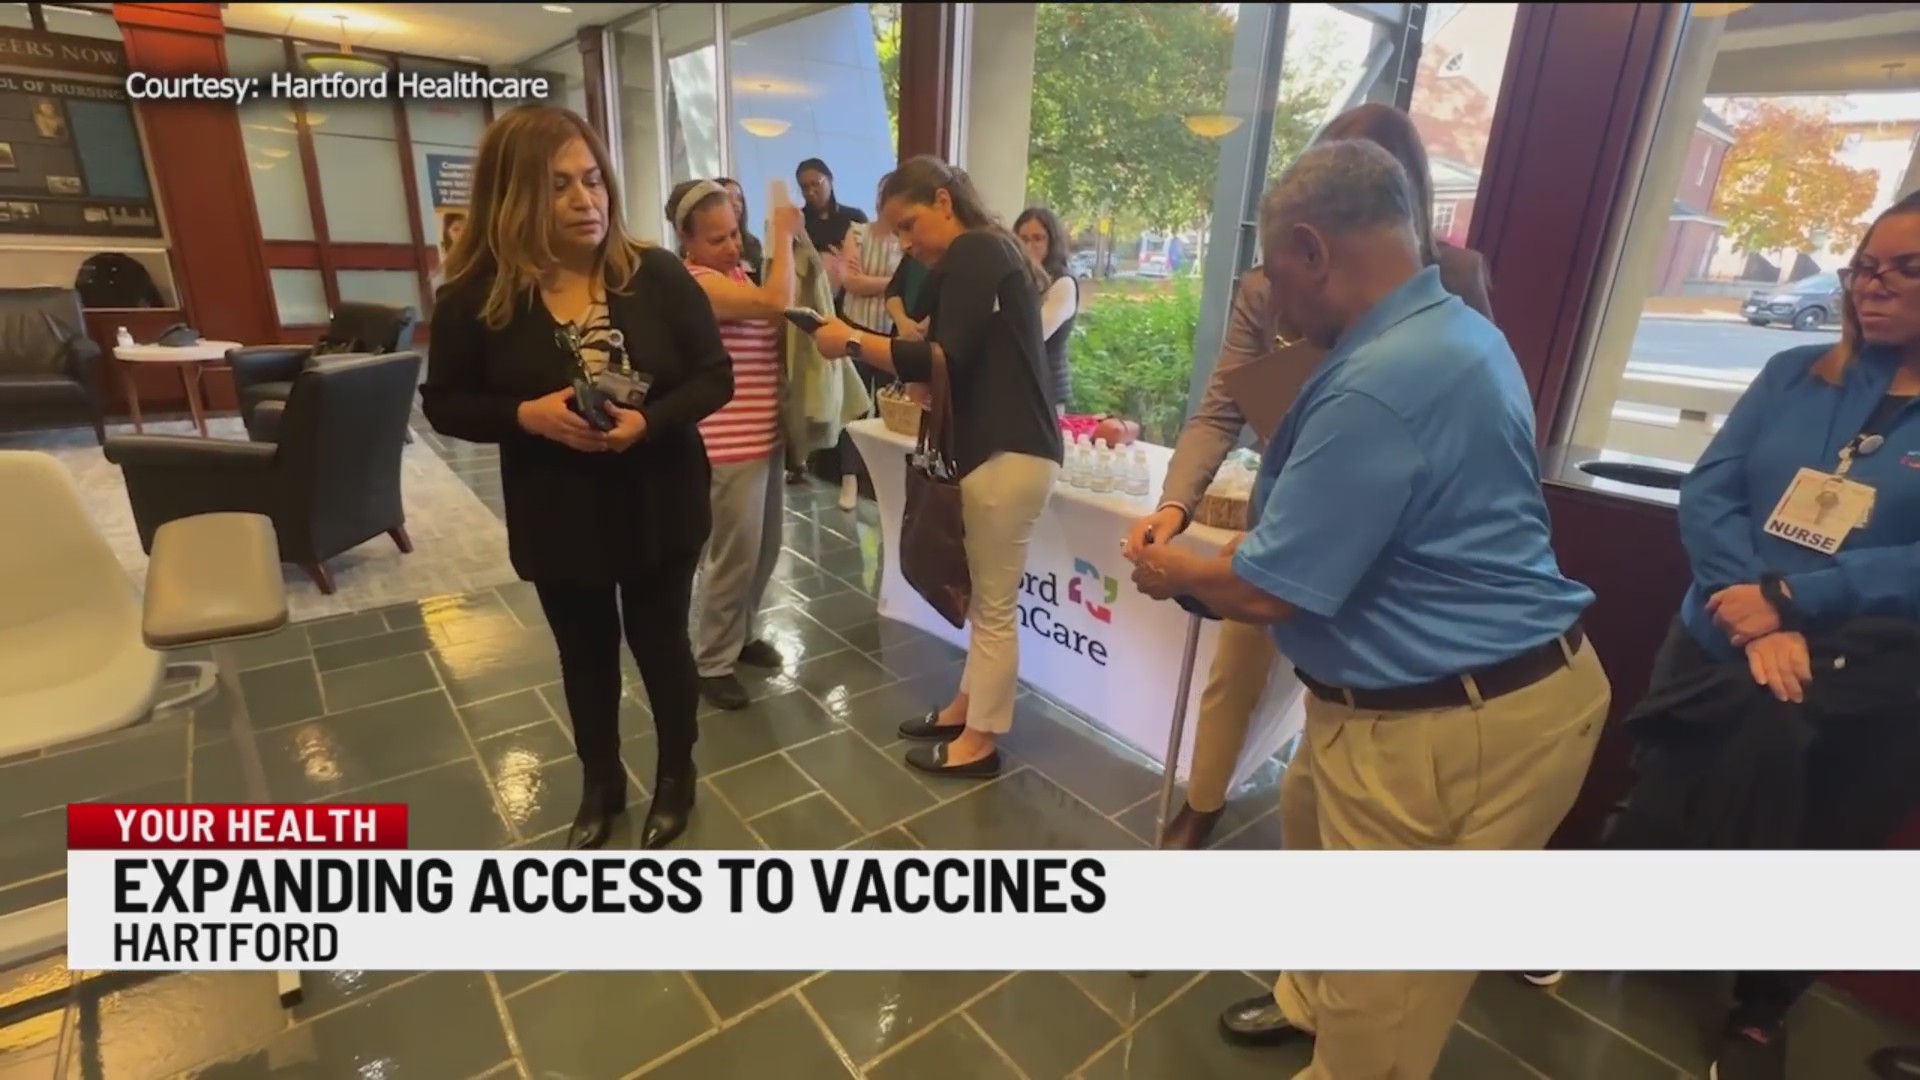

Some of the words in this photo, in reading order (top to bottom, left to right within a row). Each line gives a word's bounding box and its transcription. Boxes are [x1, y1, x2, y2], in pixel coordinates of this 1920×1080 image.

[61, 45, 119, 65] NOW
[23, 80, 45, 92] OF
[51, 83, 125, 100] NURSING
[1768, 519, 1837, 551] NURSE
